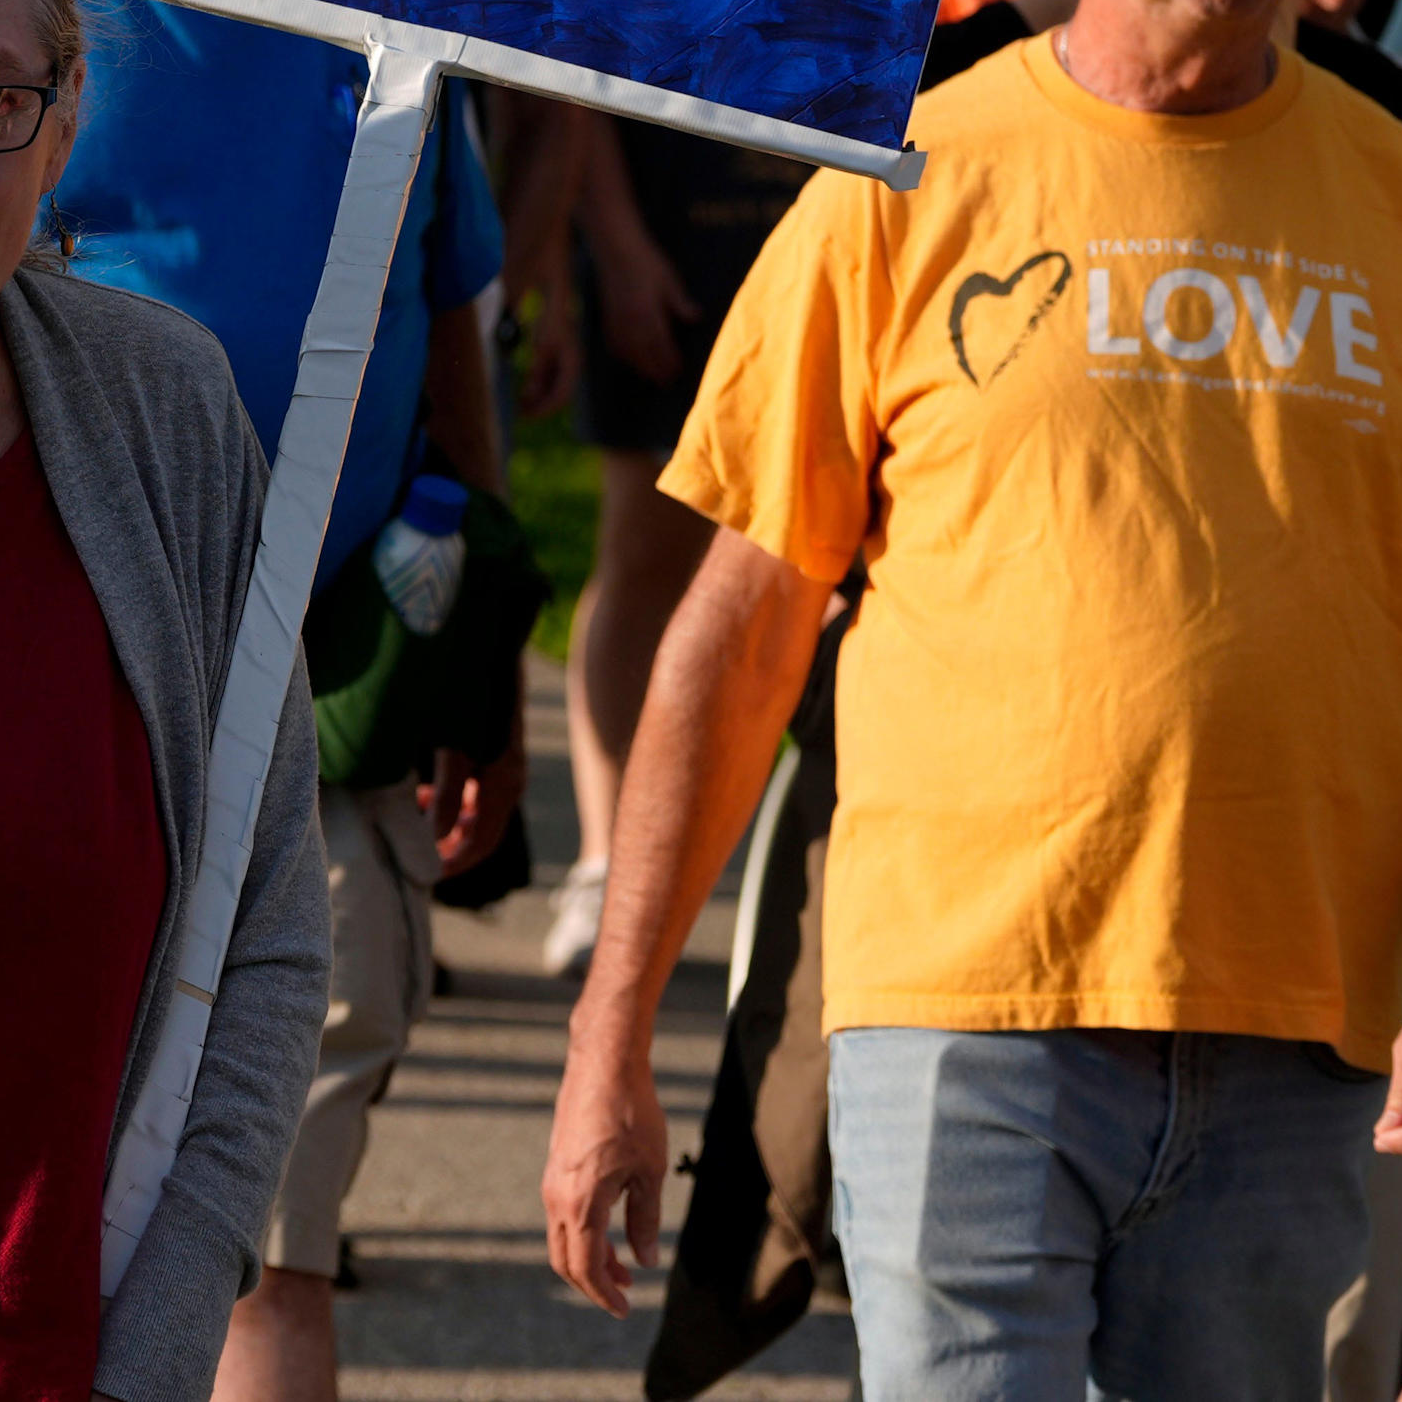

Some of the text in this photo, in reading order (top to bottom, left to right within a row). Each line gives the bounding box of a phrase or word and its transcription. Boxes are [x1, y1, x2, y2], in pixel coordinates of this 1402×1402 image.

[1086, 237, 1207, 259] STANDING
[1211, 241, 1247, 263] ON
[1251, 246, 1294, 270] THE
[1299, 255, 1347, 281] SIDE
[1087, 267, 1384, 387] LOVE
